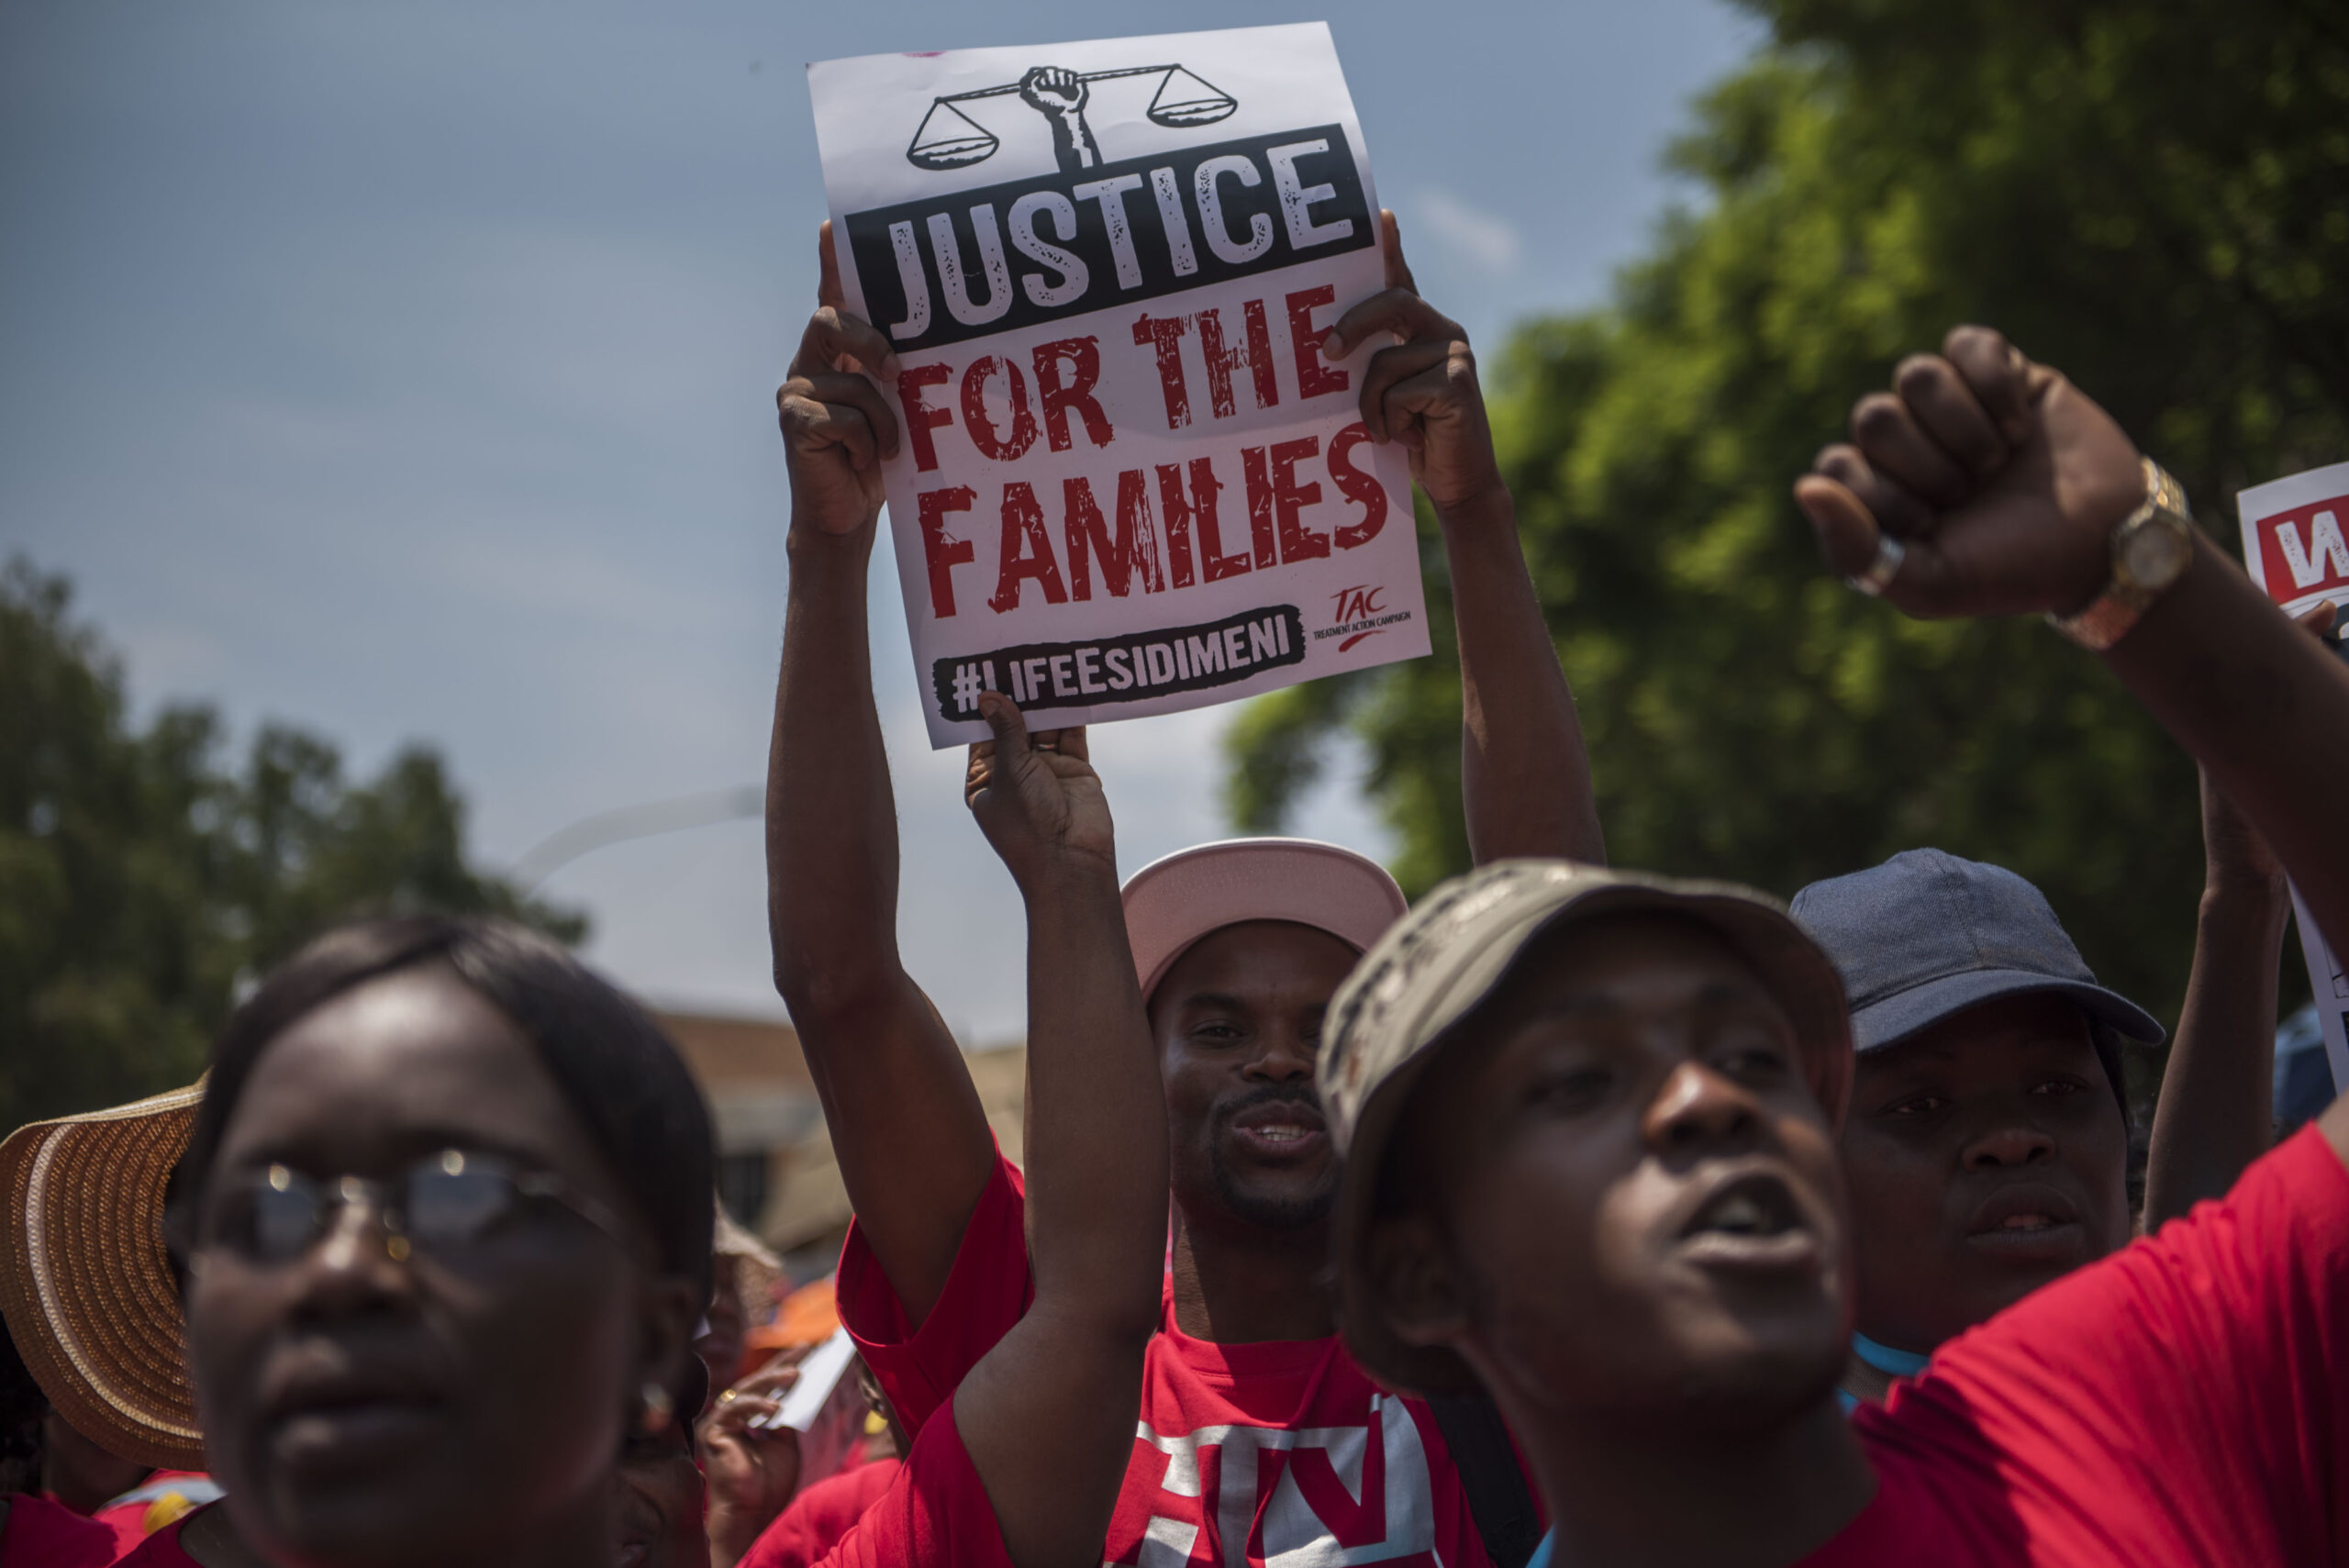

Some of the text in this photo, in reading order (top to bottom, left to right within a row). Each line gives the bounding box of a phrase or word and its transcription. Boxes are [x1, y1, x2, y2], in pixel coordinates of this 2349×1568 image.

[887, 139, 1353, 340] JUSTICE
[896, 284, 1351, 473] FOR THE
[918, 420, 1388, 619] FAMILIES
[1330, 584, 1388, 624] TAC
[1313, 610, 1411, 640] TREATMENT ACTION CAMPAIGN
